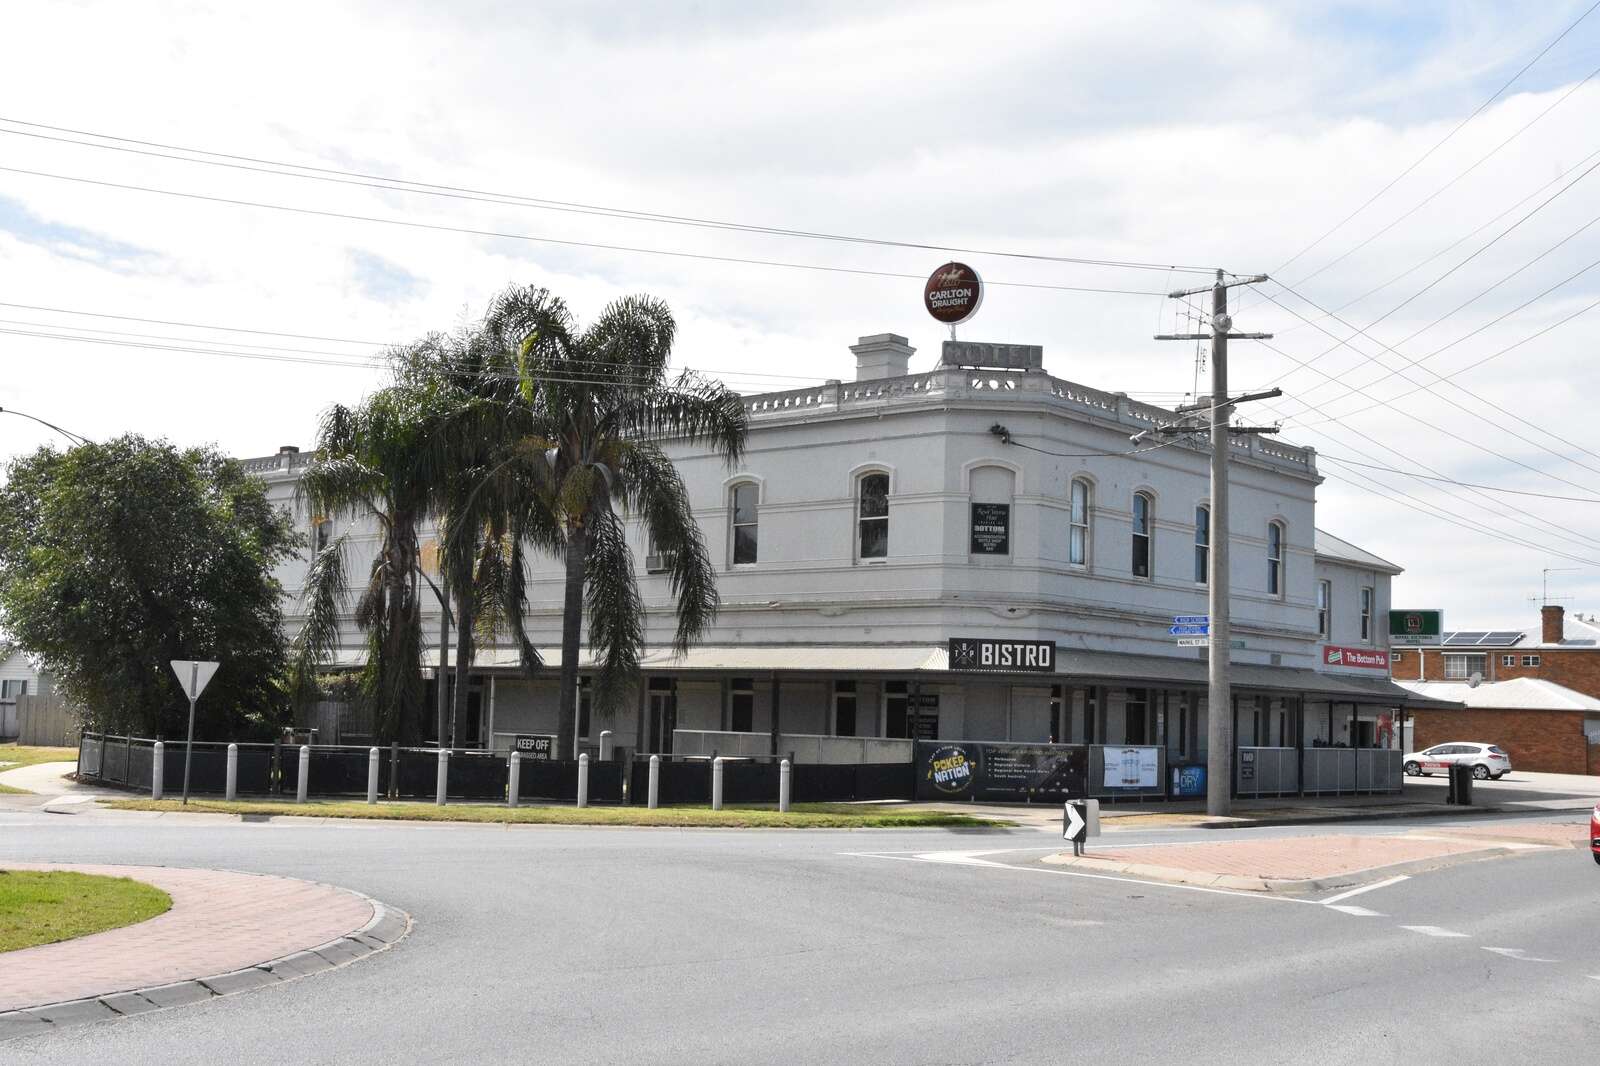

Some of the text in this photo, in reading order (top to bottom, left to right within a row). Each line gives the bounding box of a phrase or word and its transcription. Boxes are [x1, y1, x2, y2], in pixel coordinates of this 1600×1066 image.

[929, 288, 972, 301] CARLTON
[932, 298, 969, 309] DRAUGHT
[981, 643, 1050, 667] BISTRO
[1346, 651, 1385, 665] The Bottom Pub
[517, 738, 550, 751] KEEP OFF
[933, 755, 964, 772] POKER
[934, 762, 970, 783] NATION
[1181, 775, 1199, 788] DRY
